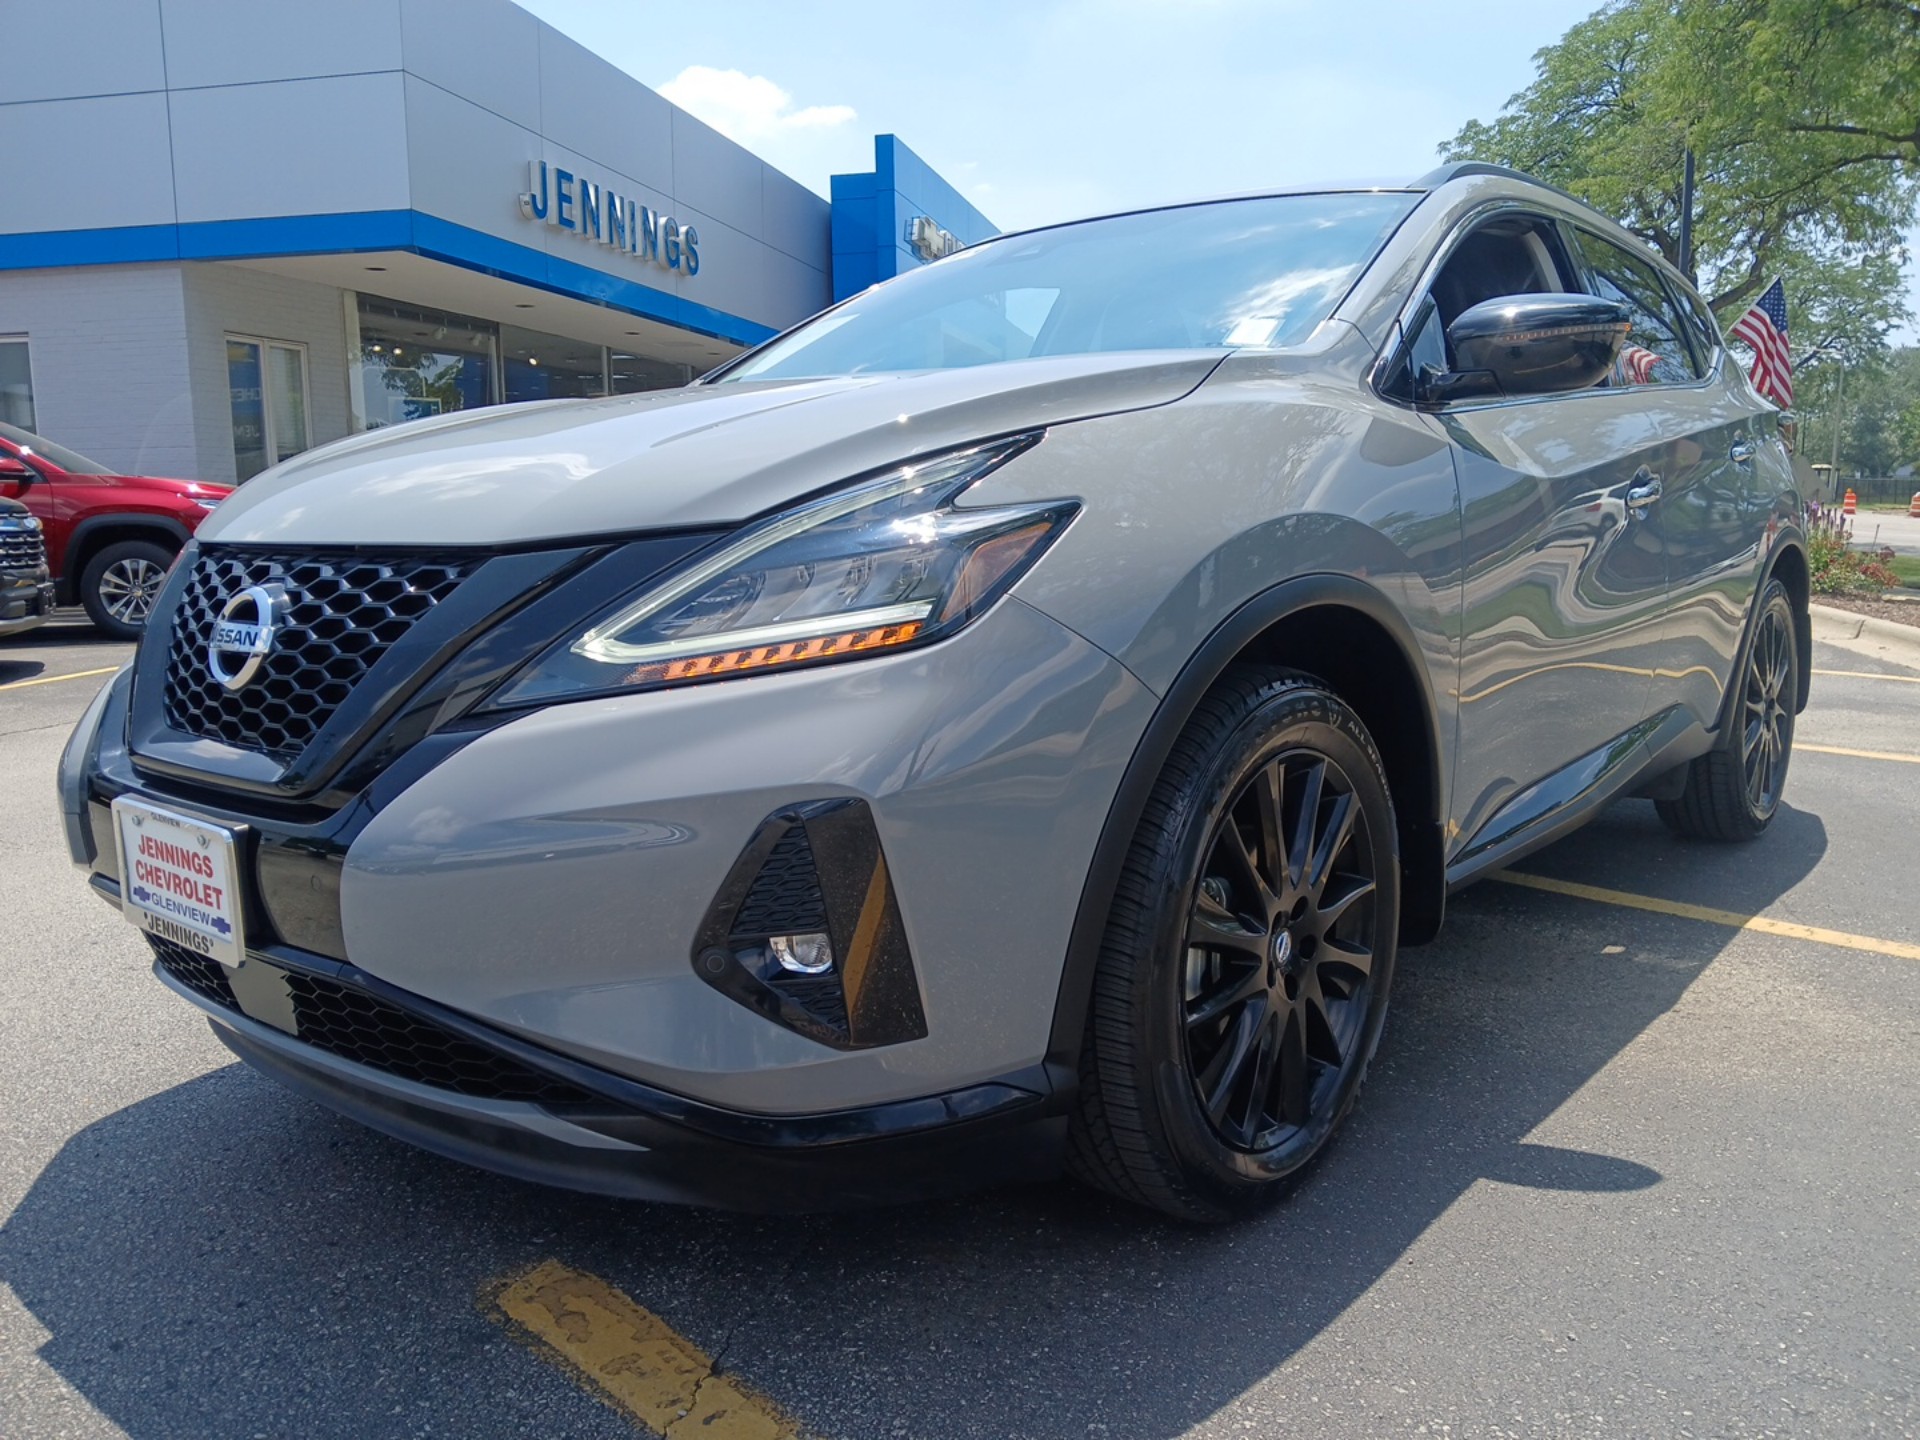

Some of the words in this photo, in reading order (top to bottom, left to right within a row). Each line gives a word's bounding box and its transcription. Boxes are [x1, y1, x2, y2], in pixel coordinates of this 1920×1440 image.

[519, 159, 700, 276] JENNINGS
[138, 834, 214, 879] JENNINGS
[135, 859, 223, 911] CHEVROLET
[151, 892, 211, 926] GLENVIEW
